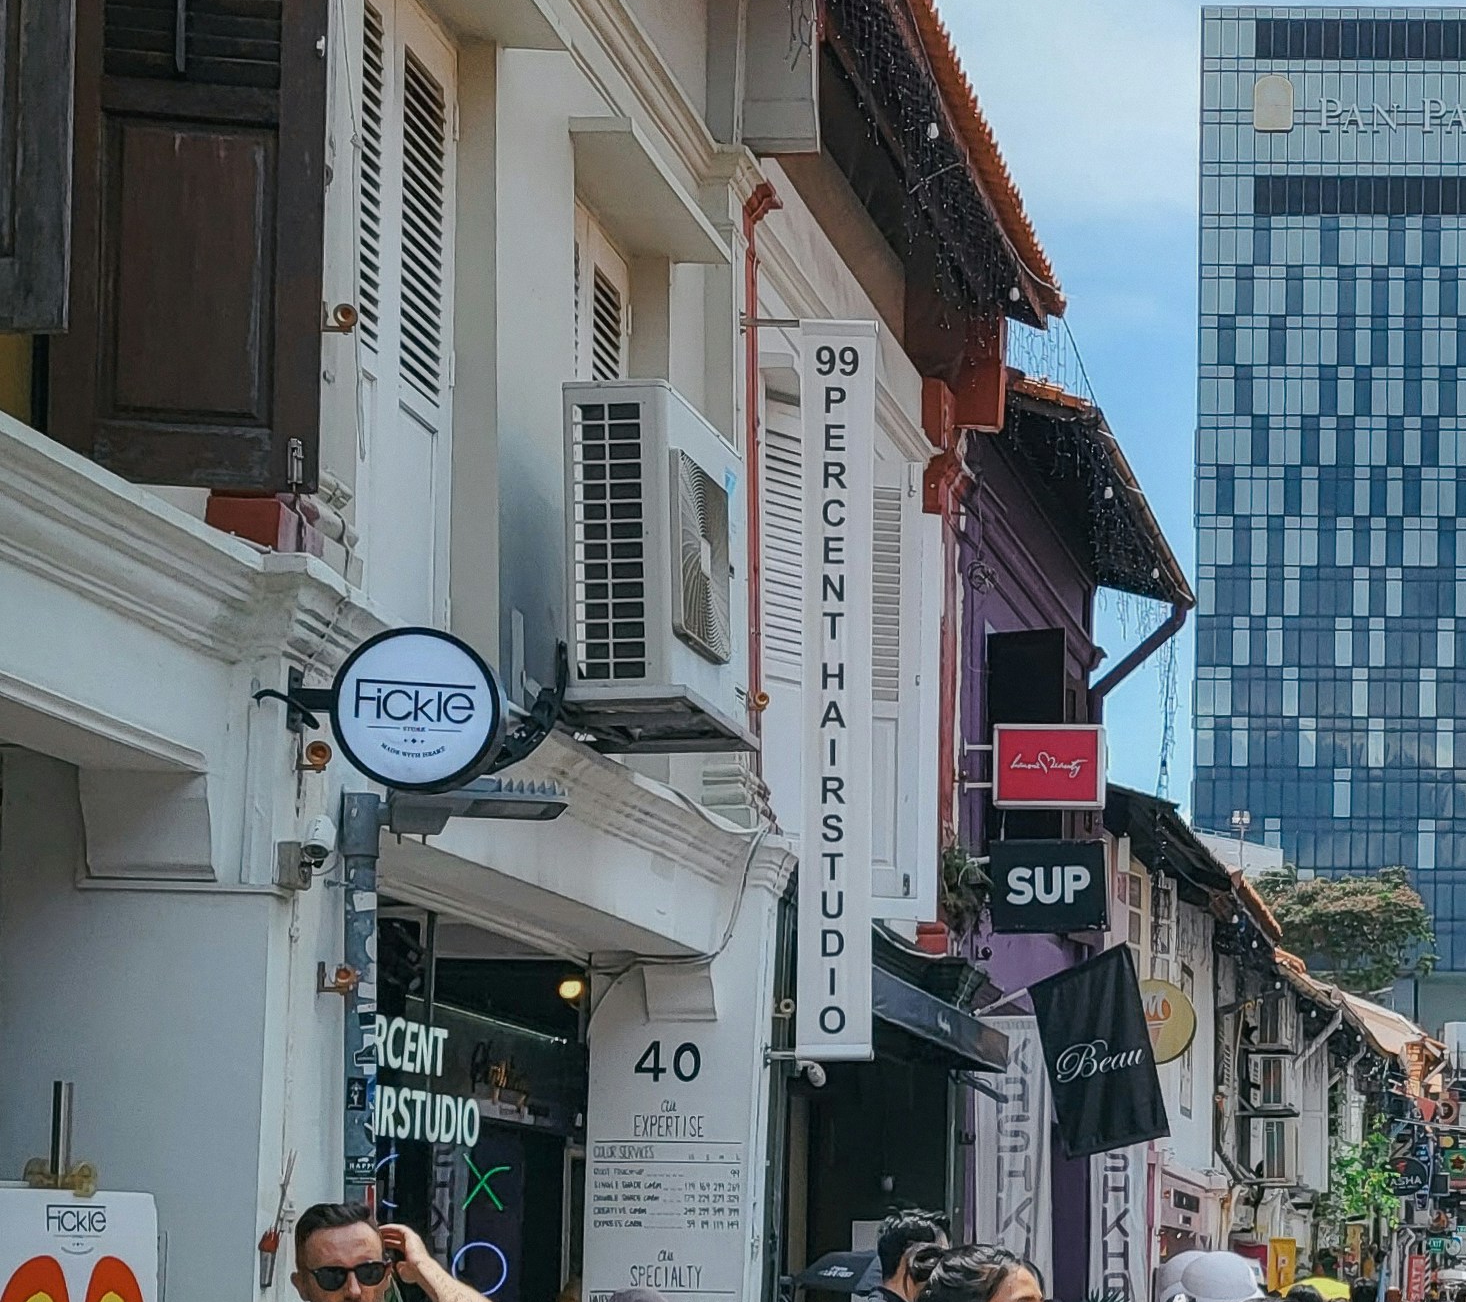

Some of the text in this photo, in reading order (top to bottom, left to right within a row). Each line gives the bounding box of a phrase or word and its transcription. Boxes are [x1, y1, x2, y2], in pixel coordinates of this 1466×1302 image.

[1318, 97, 1400, 134] PAN
[815, 345, 860, 377] 99
[821, 387, 847, 640] PERCENT
[380, 742, 400, 756] MADE
[401, 750, 421, 758] WITH
[1006, 865, 1091, 905] SUP
[375, 1013, 449, 1077] RCENT
[634, 1040, 702, 1082] 40
[1055, 1039, 1146, 1084] Beau
[375, 1084, 480, 1148] IRSTUDIO
[634, 1115, 704, 1138] EXPERTISE
[630, 1265, 702, 1288] SPECIALTY
